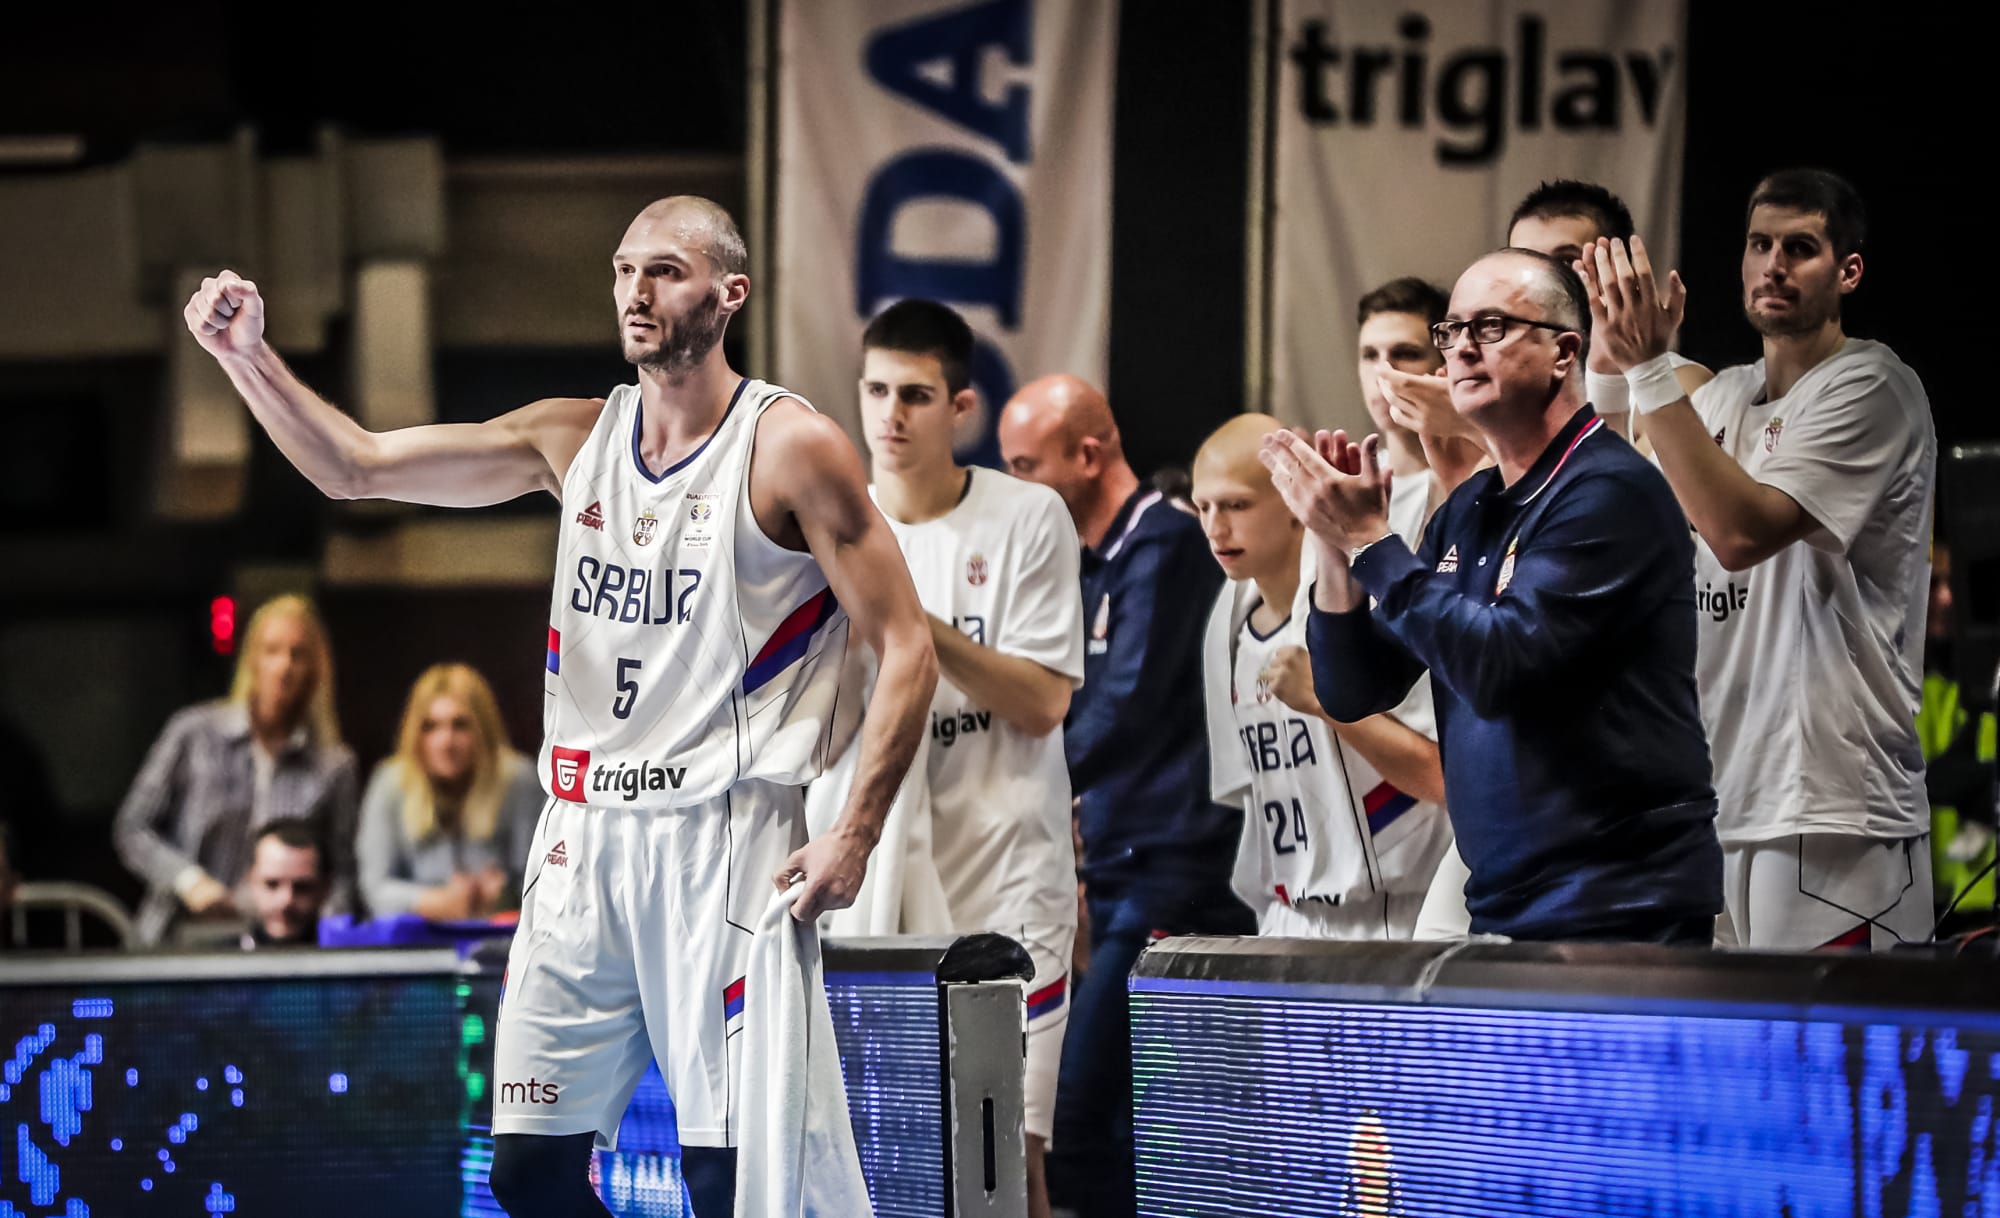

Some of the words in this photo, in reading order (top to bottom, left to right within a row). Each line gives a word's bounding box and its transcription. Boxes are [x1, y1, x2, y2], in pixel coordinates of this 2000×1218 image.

[1289, 12, 1676, 168] triglav
[576, 512, 605, 532] PEAK
[571, 555, 702, 625] SRBIJA
[1696, 582, 1748, 622] rigla
[613, 658, 642, 720] 5
[932, 708, 991, 747] iglav
[592, 760, 687, 801] triglav
[1264, 797, 1308, 856] 24
[547, 852, 568, 868] PEAK
[501, 1077, 559, 1104] mts
